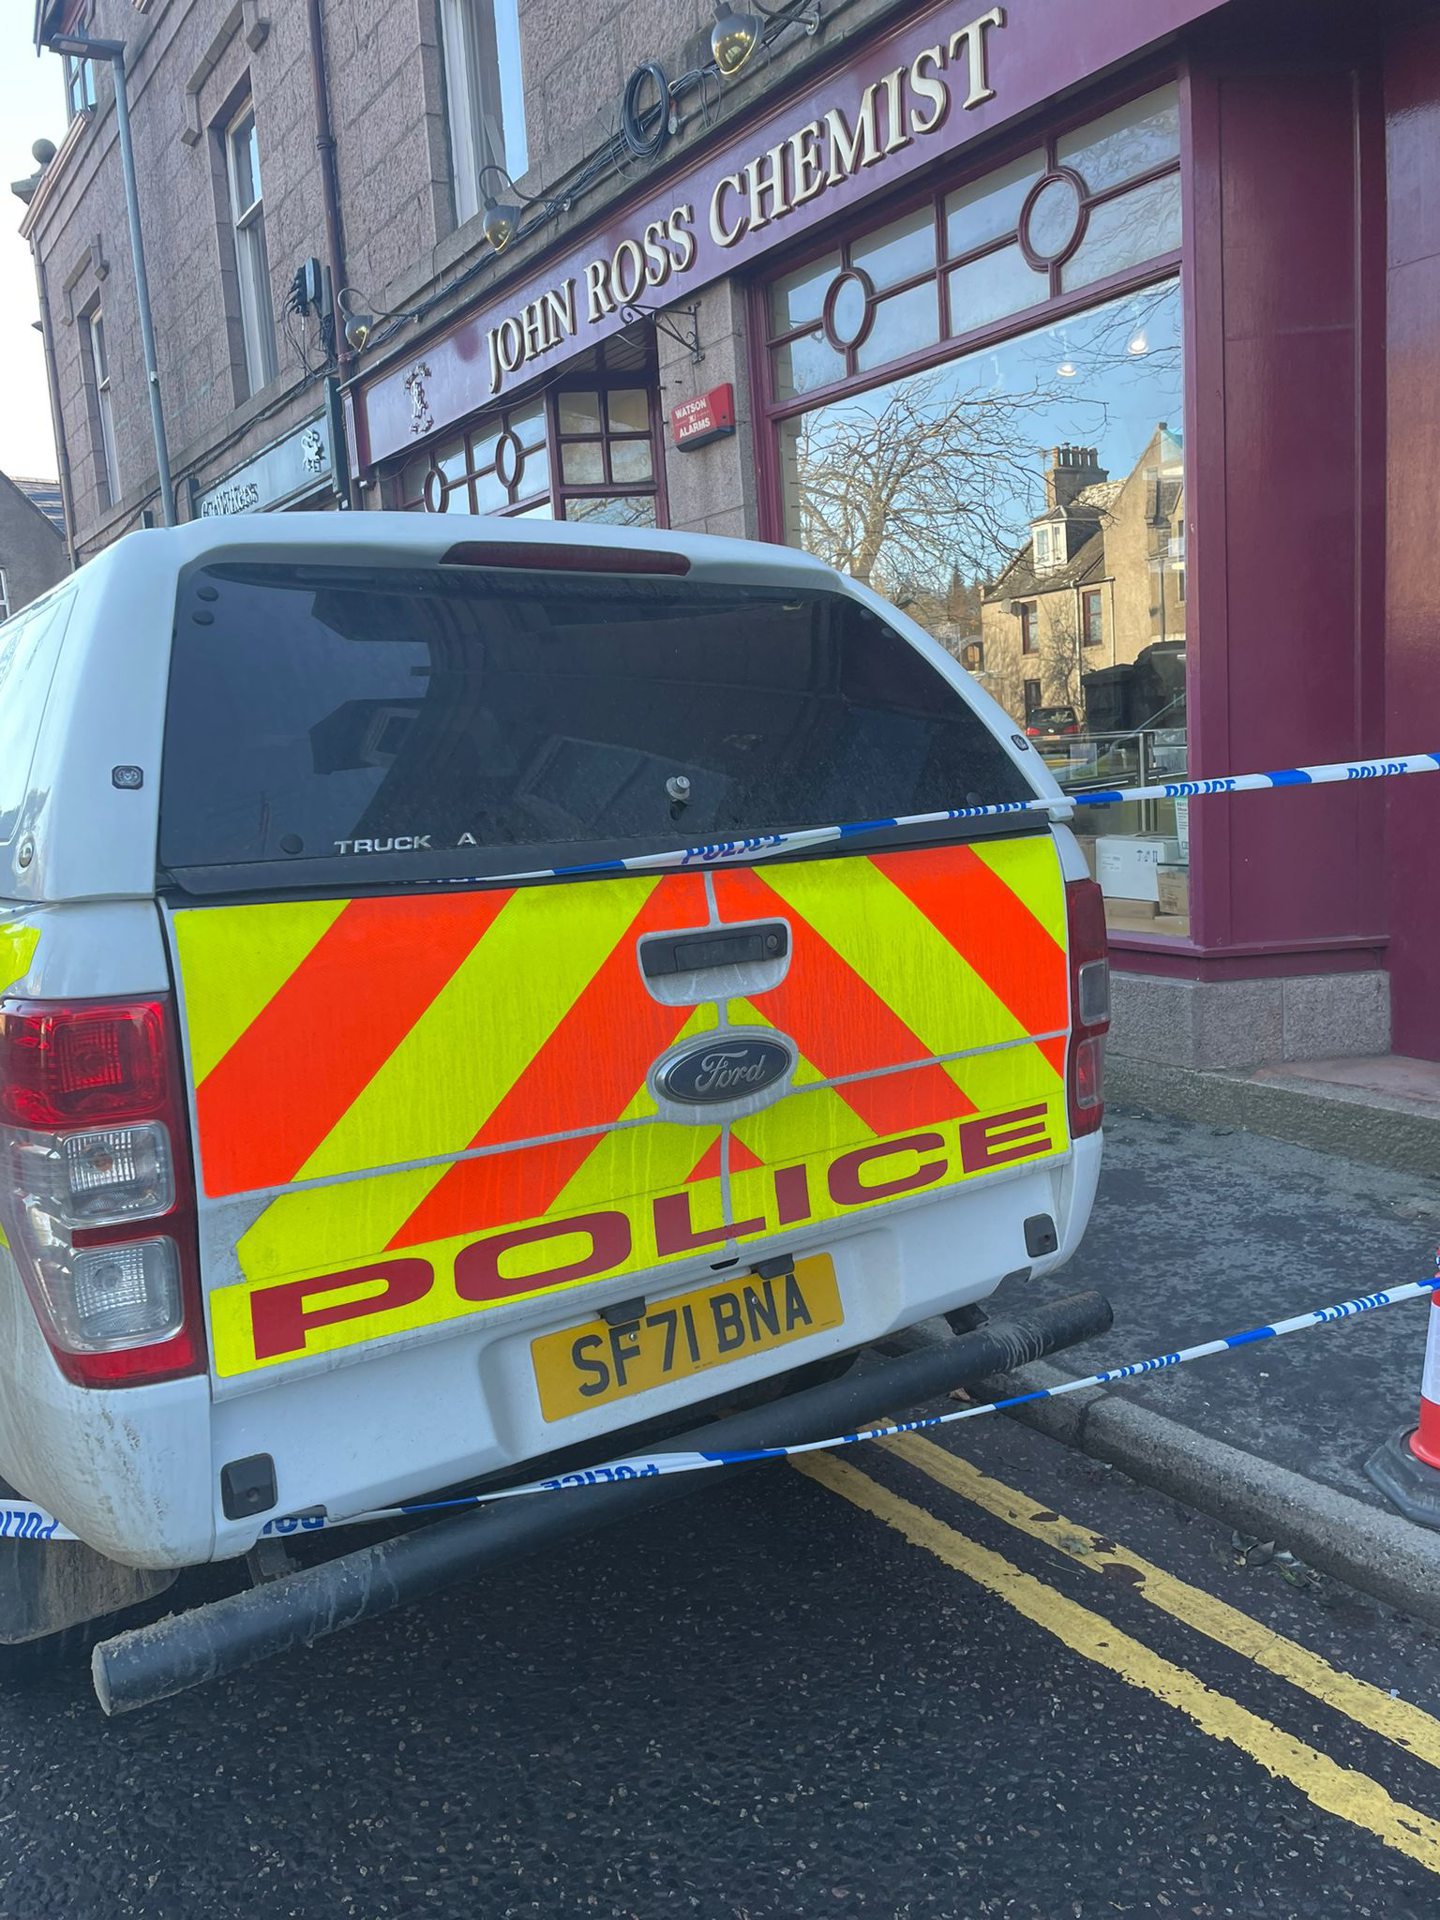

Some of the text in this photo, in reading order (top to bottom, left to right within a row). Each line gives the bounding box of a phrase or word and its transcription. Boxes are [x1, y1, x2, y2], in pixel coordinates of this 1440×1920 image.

[486, 7, 1006, 395] JOHN ROSS CHEMIST
[674, 398, 707, 419] WATSON
[679, 417, 711, 439] ALARMS
[334, 832, 477, 855] TRUCK A
[694, 1049, 767, 1093] Ford
[250, 1102, 1053, 1361] POLICE
[572, 1273, 813, 1397] SF71 BNA
